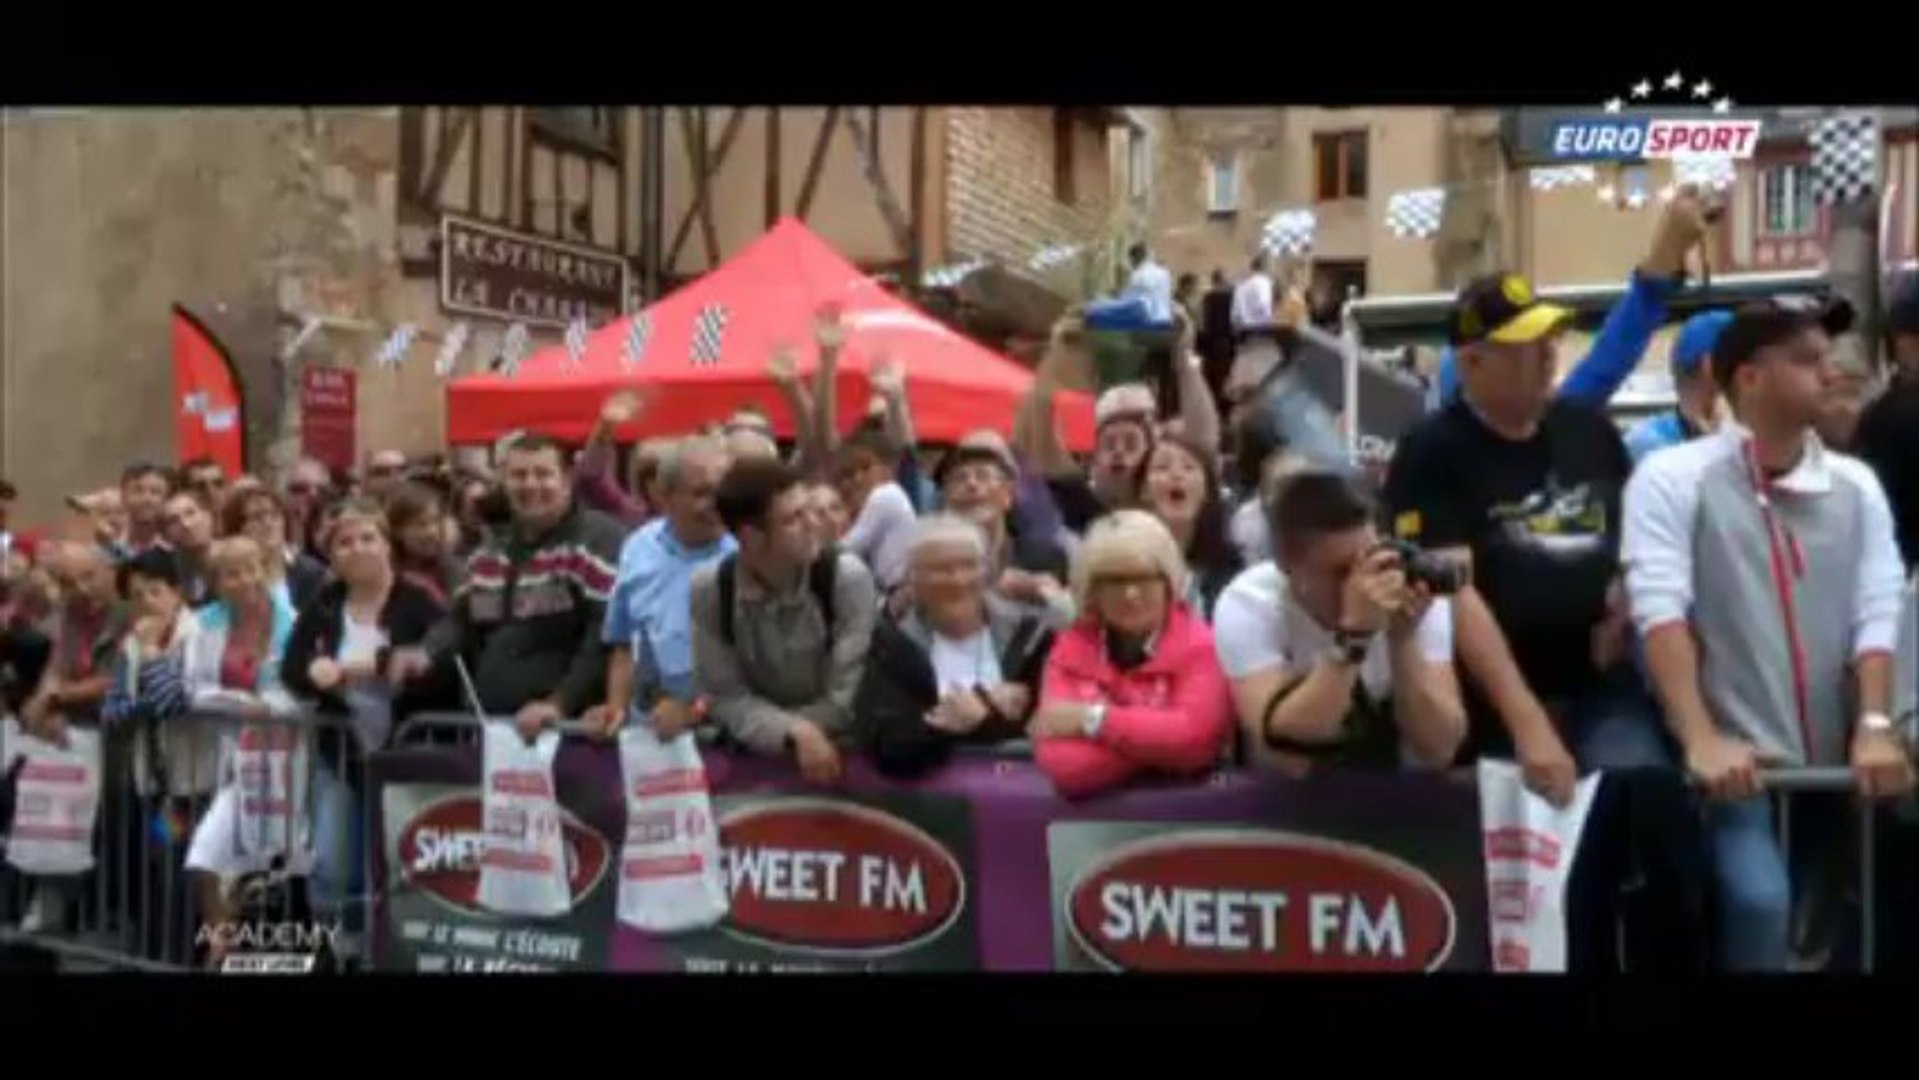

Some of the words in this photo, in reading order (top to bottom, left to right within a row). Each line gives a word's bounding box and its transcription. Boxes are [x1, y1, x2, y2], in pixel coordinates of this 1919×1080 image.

[453, 231, 617, 289] RESTAURANT
[859, 854, 927, 915] FM
[1101, 882, 1288, 951] SWEET
[1309, 893, 1406, 959] FM
